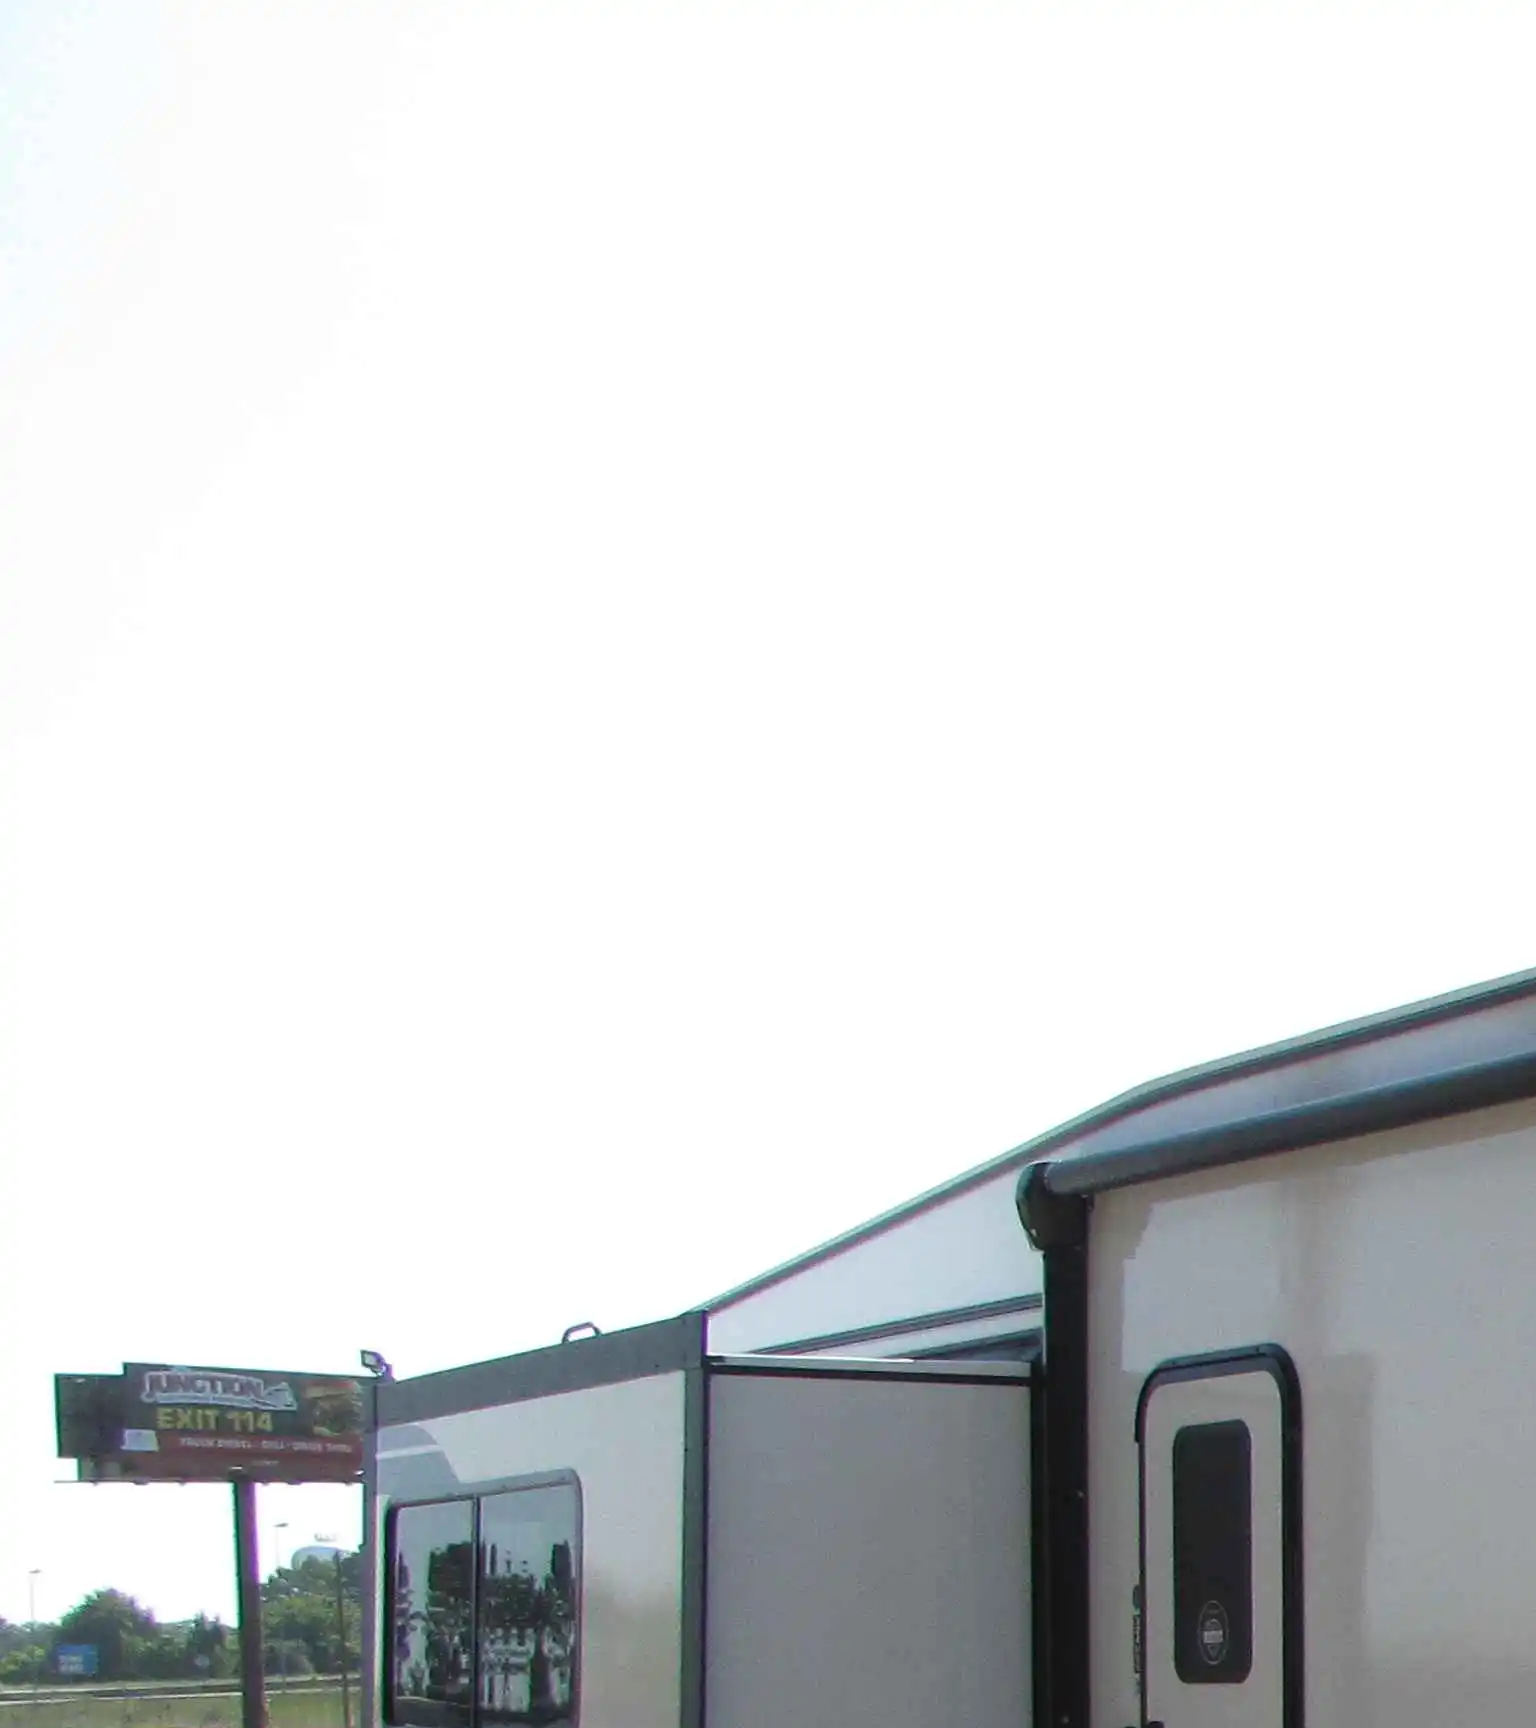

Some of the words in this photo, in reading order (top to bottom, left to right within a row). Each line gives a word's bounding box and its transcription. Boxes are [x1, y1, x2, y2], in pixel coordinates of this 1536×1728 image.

[141, 1371, 265, 1403] JUNCTION
[156, 1407, 219, 1430] EXIT
[225, 1410, 273, 1433] 114
